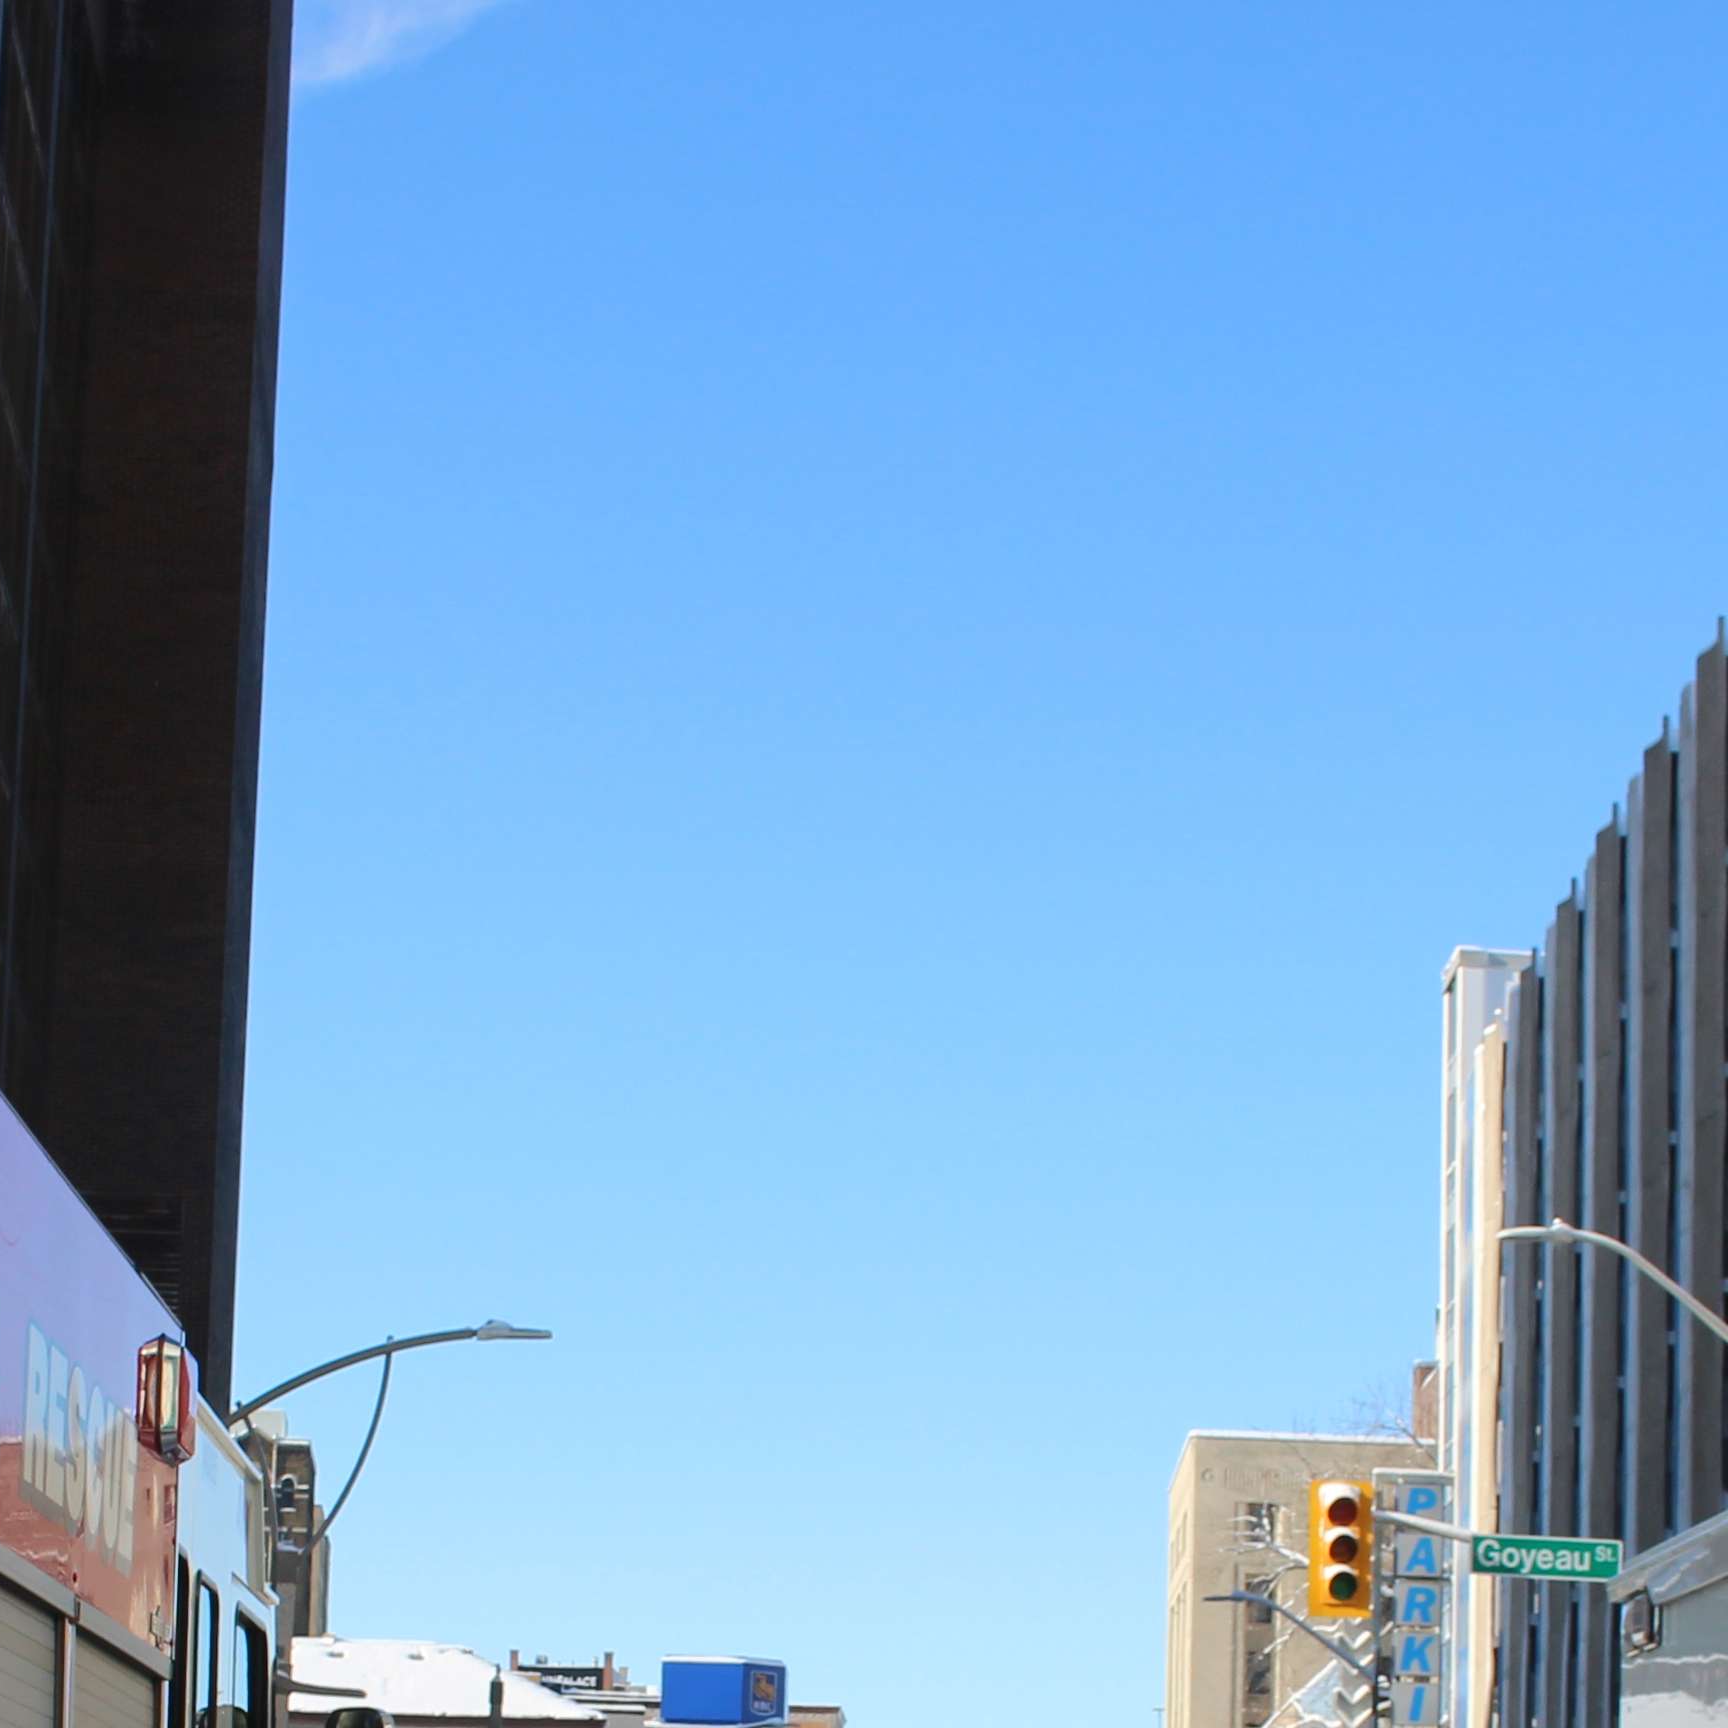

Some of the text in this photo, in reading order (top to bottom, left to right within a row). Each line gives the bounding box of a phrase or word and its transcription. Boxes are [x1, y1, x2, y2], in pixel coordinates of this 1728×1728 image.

[20, 1318, 139, 1570] RESCUE
[1477, 1538, 1617, 1574] Goyeau St.
